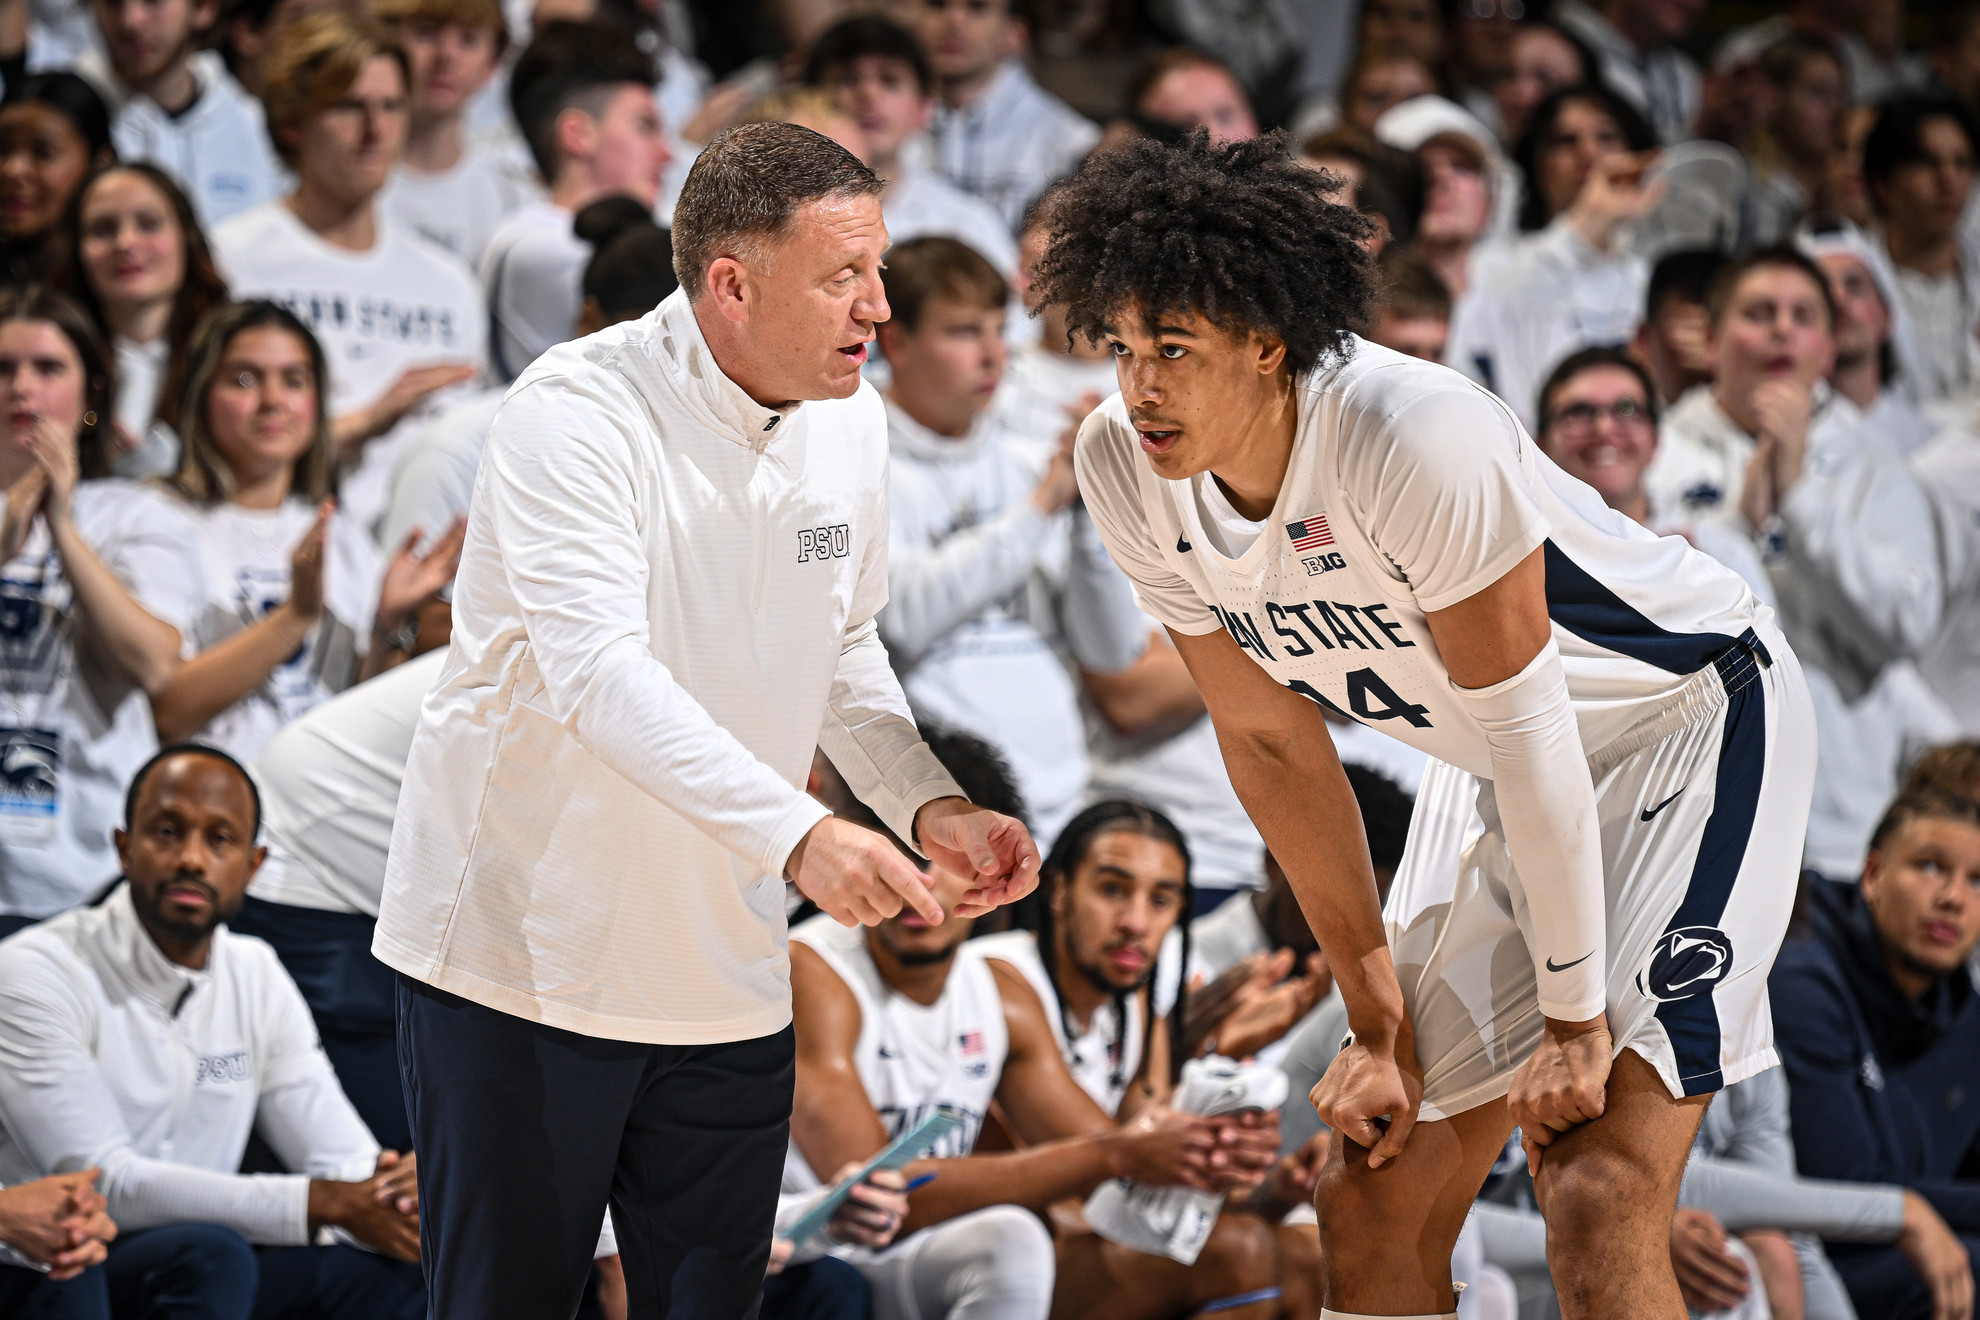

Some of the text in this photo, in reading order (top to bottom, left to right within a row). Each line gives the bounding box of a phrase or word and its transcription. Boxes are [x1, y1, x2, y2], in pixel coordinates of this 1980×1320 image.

[797, 523, 850, 563] PSU
[1265, 600, 1416, 658] STATE
[195, 1051, 250, 1086] PSU
